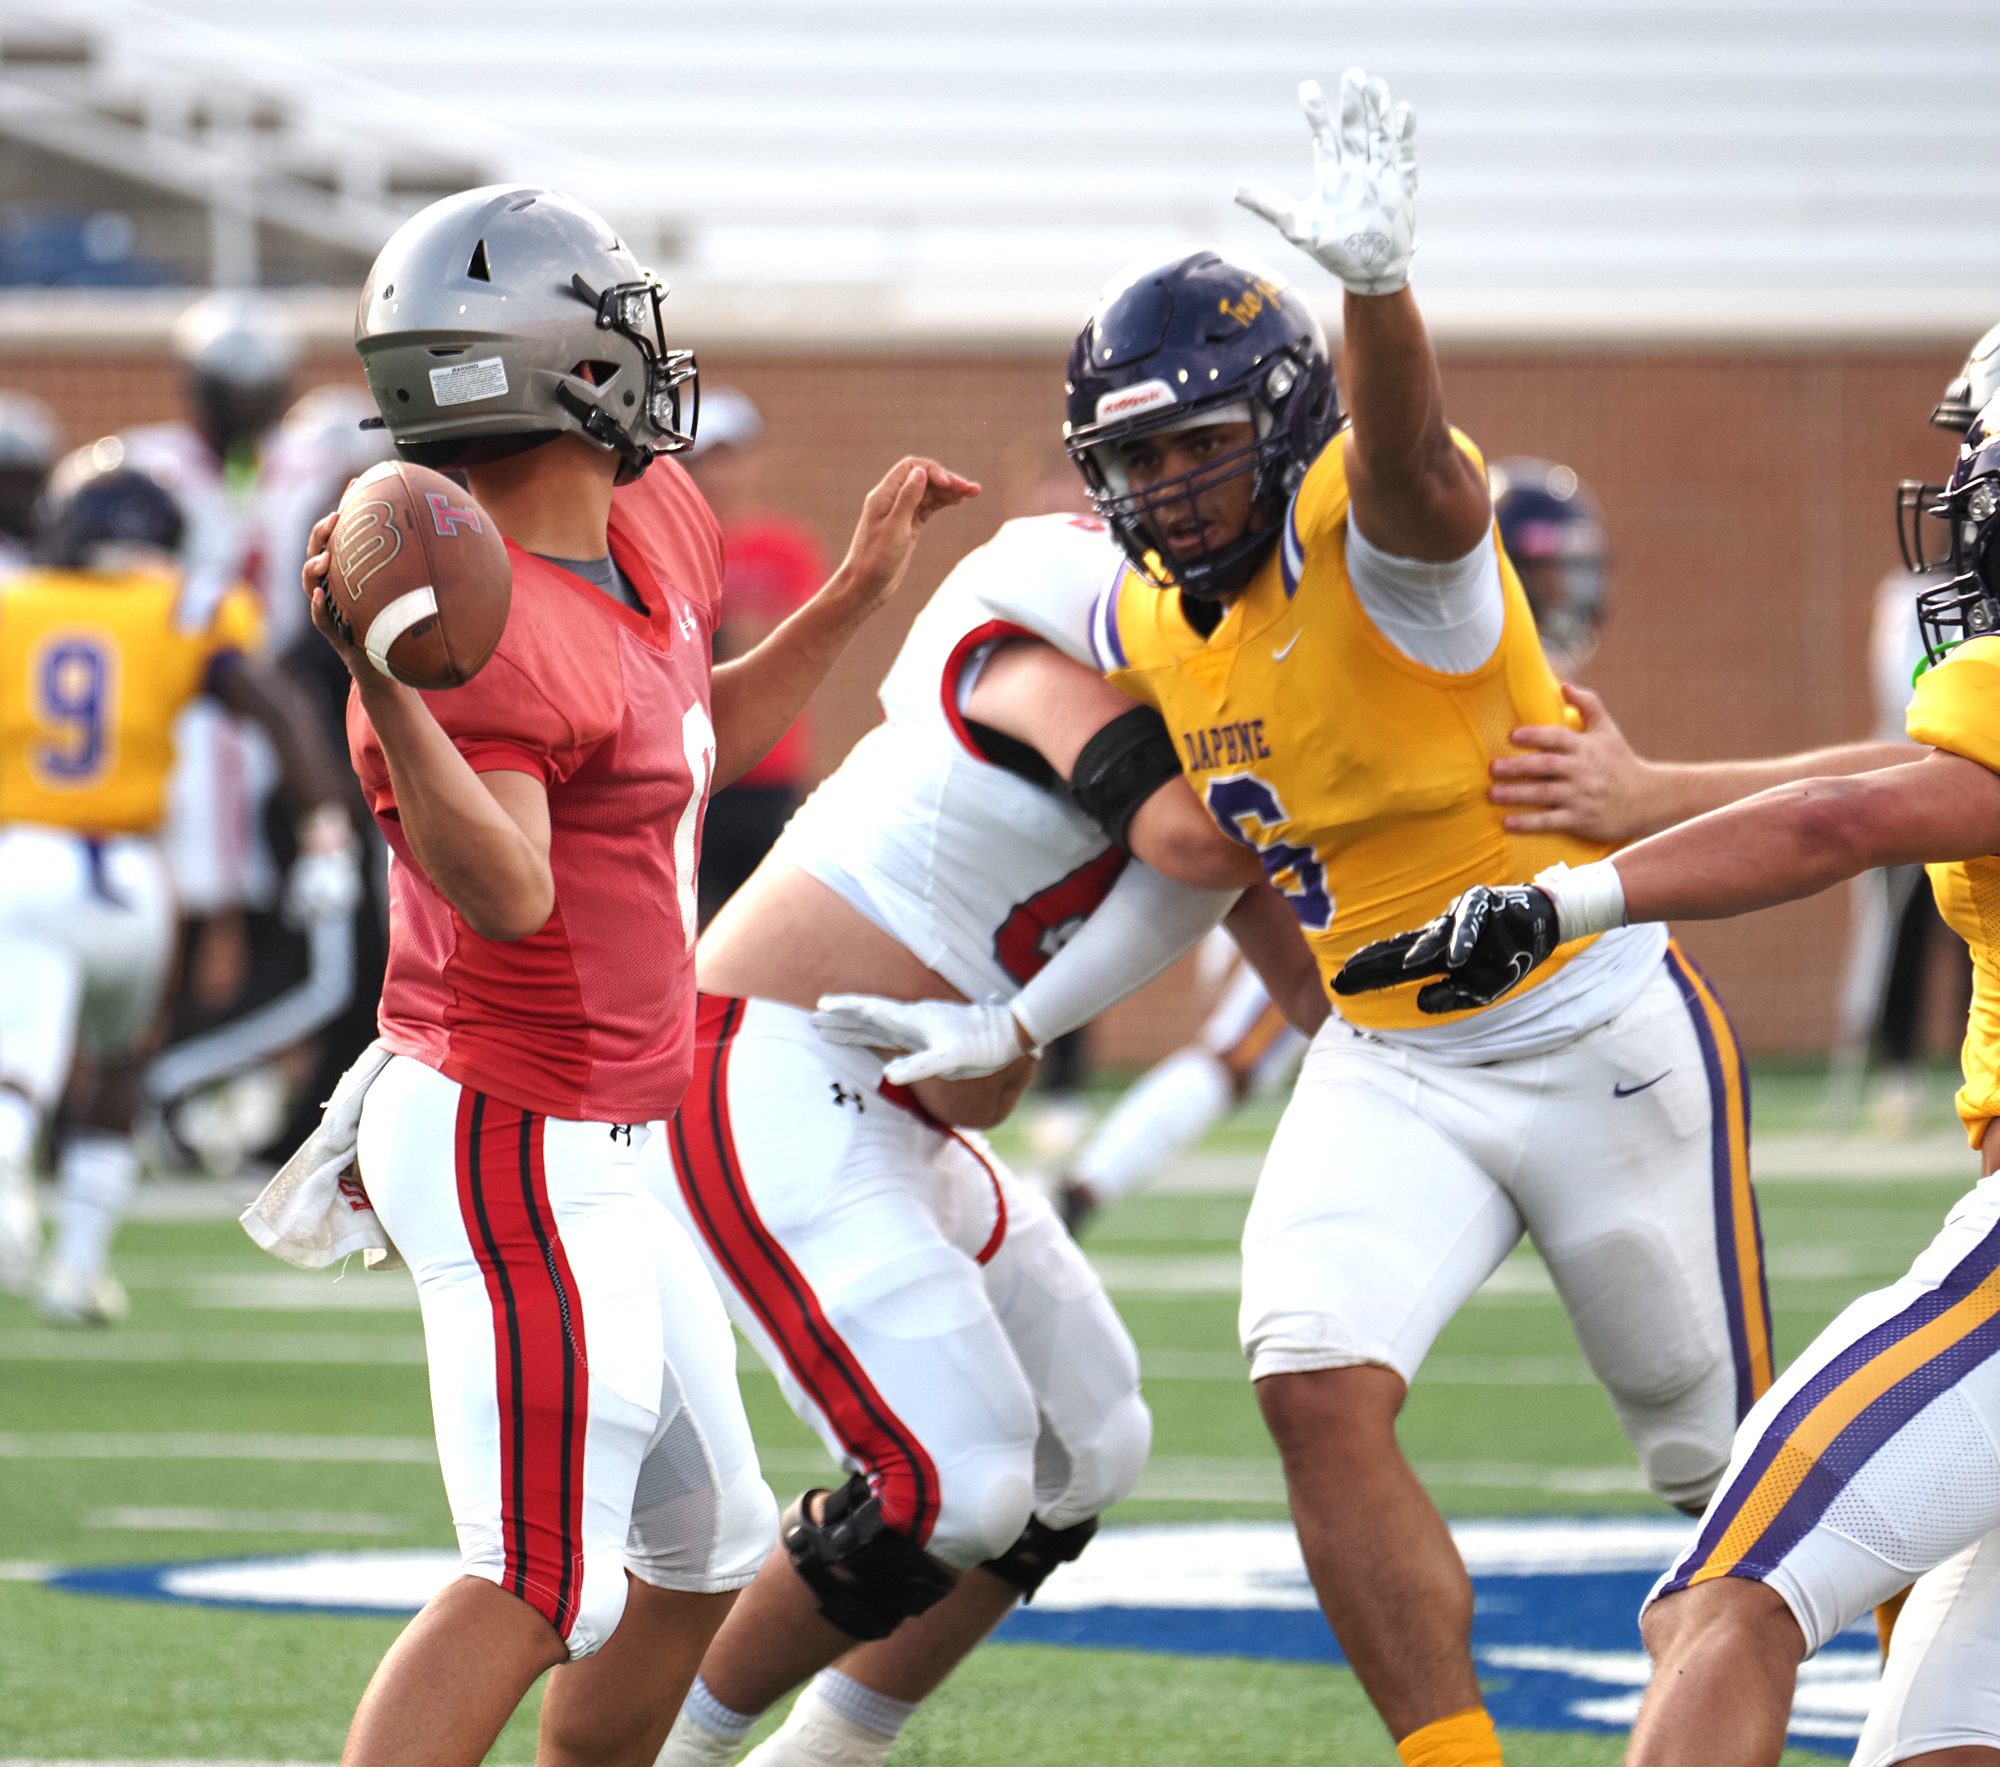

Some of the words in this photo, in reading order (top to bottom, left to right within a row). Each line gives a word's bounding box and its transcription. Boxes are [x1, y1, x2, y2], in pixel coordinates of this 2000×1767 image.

[32, 630, 112, 788] 9
[1183, 718, 1271, 772] DAPHNE
[1205, 772, 1336, 931] 6
